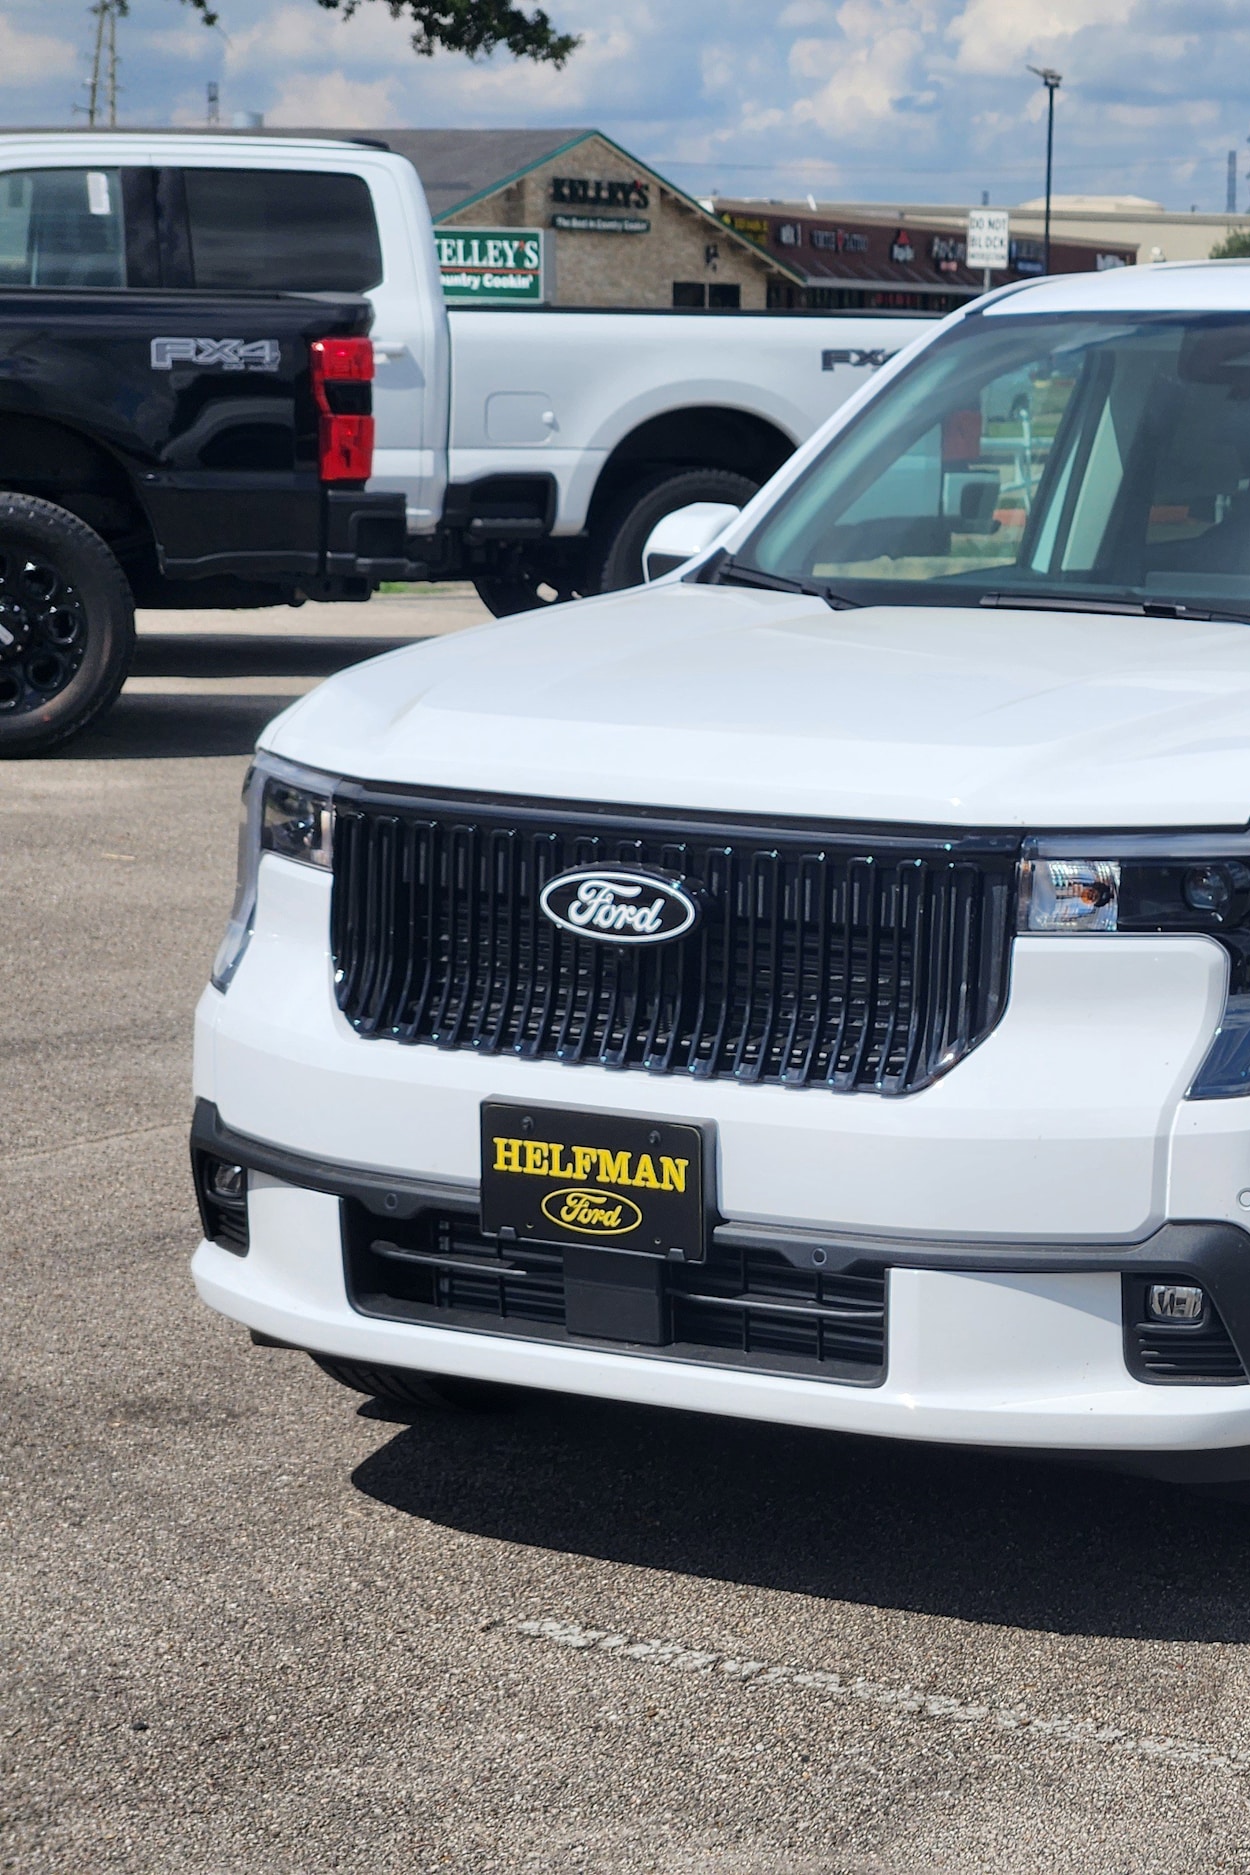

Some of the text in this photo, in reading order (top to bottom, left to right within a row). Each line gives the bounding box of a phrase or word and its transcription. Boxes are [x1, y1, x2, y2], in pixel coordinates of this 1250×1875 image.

[551, 177, 649, 209] KELLEY'S
[970, 217, 1007, 230] DO NOT
[971, 235, 1005, 249] BLOCK
[150, 336, 281, 371] FX4
[568, 879, 665, 932] Ford
[493, 1137, 689, 1193] HELFMAN
[560, 1192, 622, 1227] Ford
